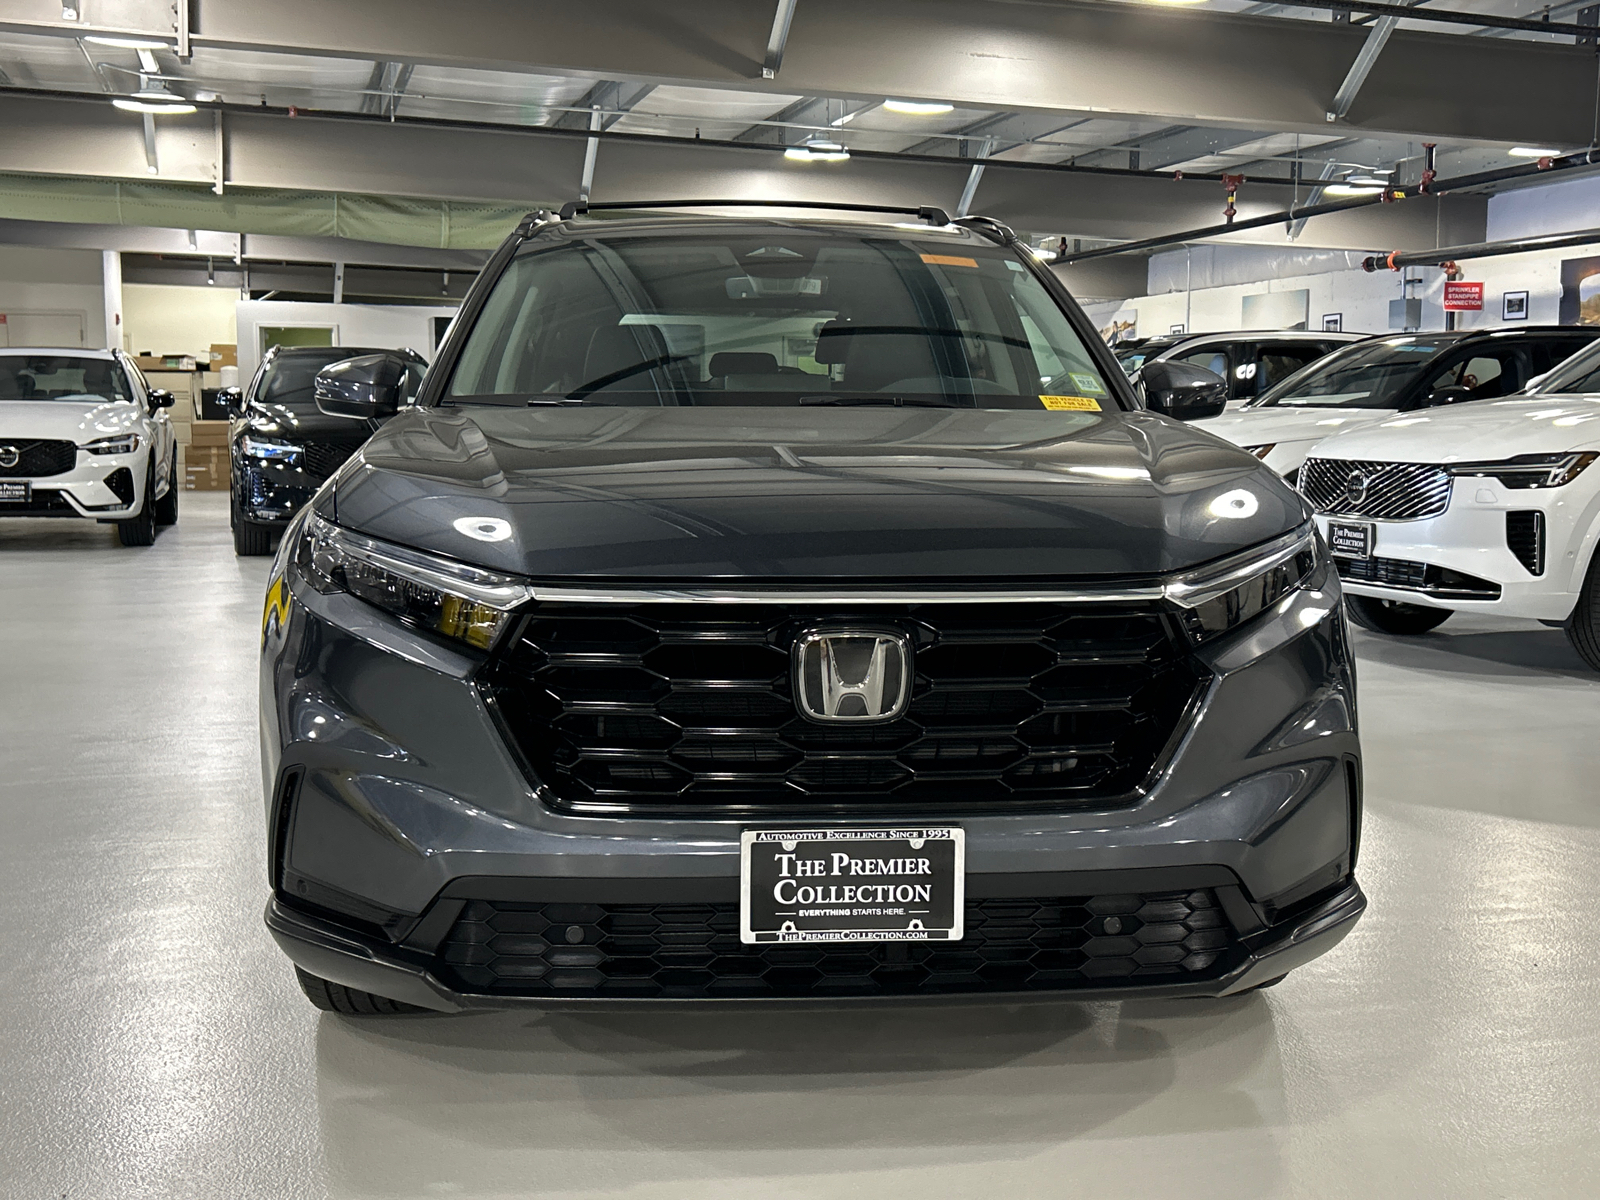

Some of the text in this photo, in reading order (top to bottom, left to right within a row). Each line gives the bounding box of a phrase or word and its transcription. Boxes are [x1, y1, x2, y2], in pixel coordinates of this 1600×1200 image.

[1344, 529, 1364, 538] PREMIER
[1332, 535, 1364, 547] COLLECTION
[758, 829, 949, 841] AUTOMOTIVE EXCELLENCE SINCE 1995
[774, 852, 932, 877] THE PREMIER
[773, 879, 932, 904] COLLECTION
[798, 909, 851, 917] EVERYTHING
[852, 908, 882, 916] STARTS
[776, 931, 928, 942] THEPREMIERCOLLECTION.COM
